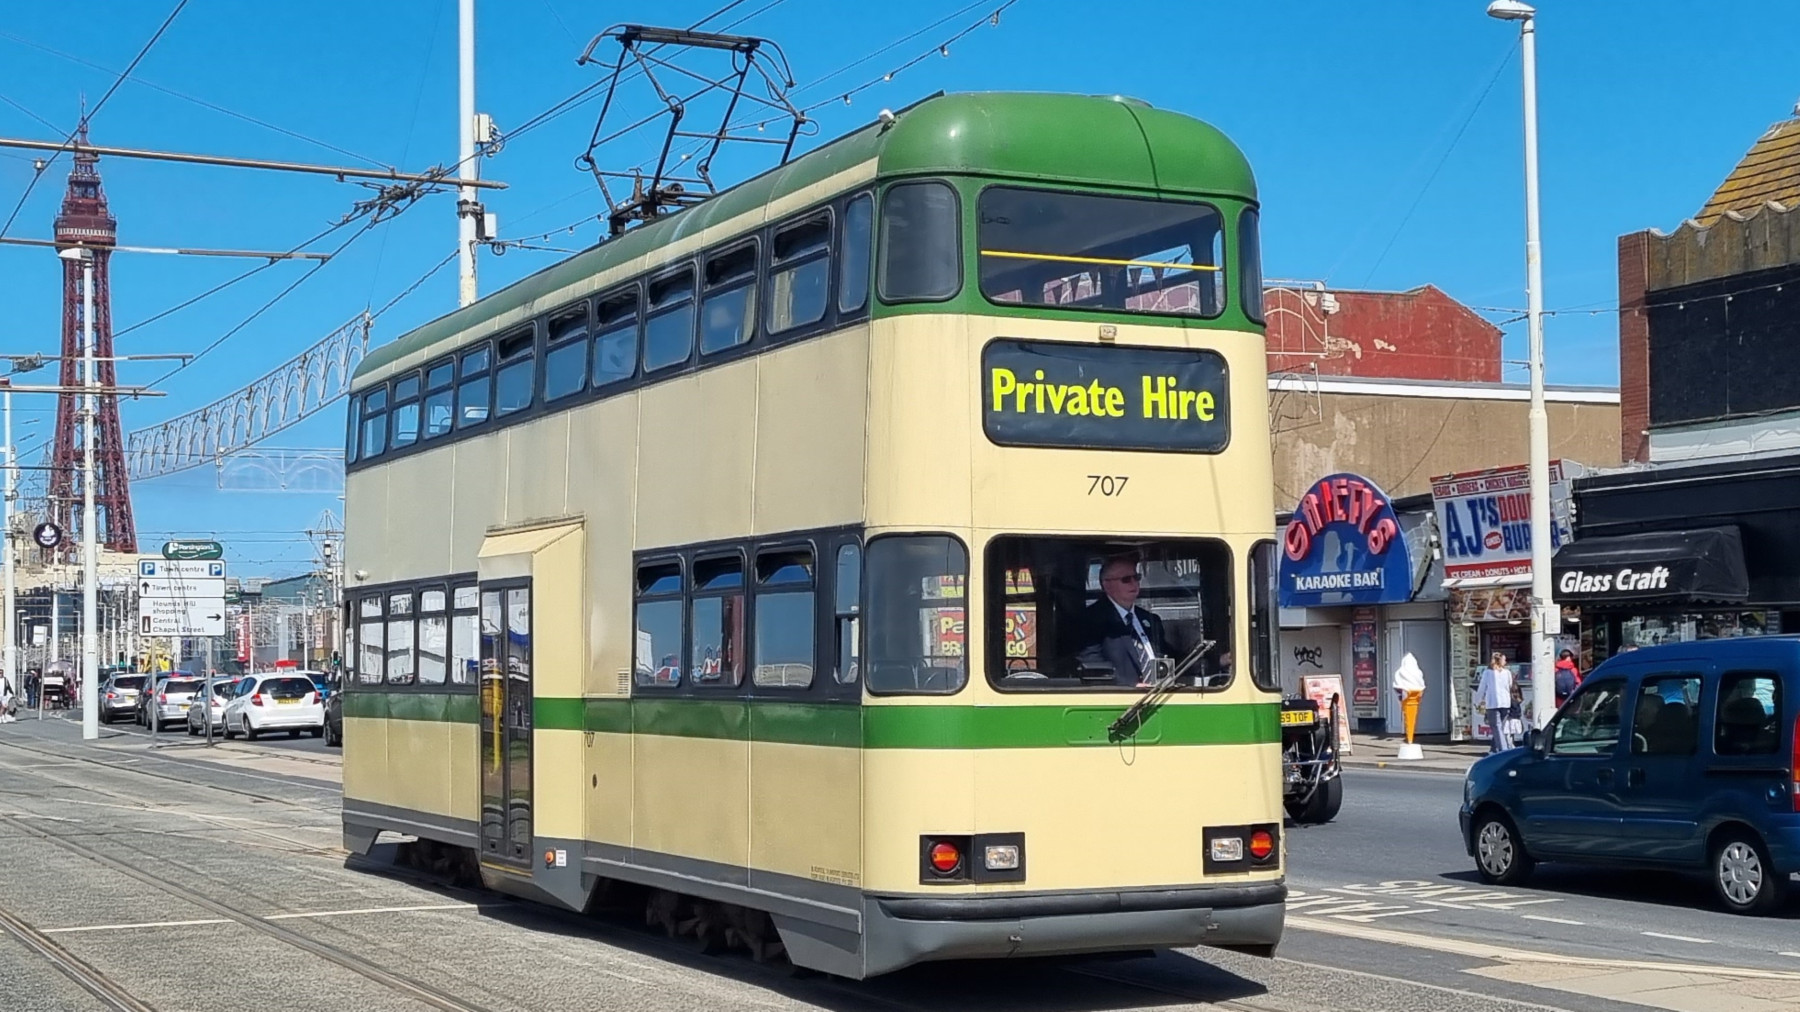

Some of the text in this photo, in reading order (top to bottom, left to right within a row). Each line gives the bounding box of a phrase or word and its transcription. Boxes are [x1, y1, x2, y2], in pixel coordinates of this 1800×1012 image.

[992, 368, 1215, 421] Private Hire
[1087, 475, 1129, 497] 707
[1497, 493, 1532, 522] DOU
[1445, 496, 1500, 559] AJ'S
[1296, 571, 1380, 591] KARAOKE BAR
[1460, 569, 1481, 578] CREAM
[1485, 567, 1510, 577] DONUTS
[1513, 566, 1526, 575] HOT
[1560, 565, 1670, 593] Glass Craft
[1293, 712, 1309, 722] TOF
